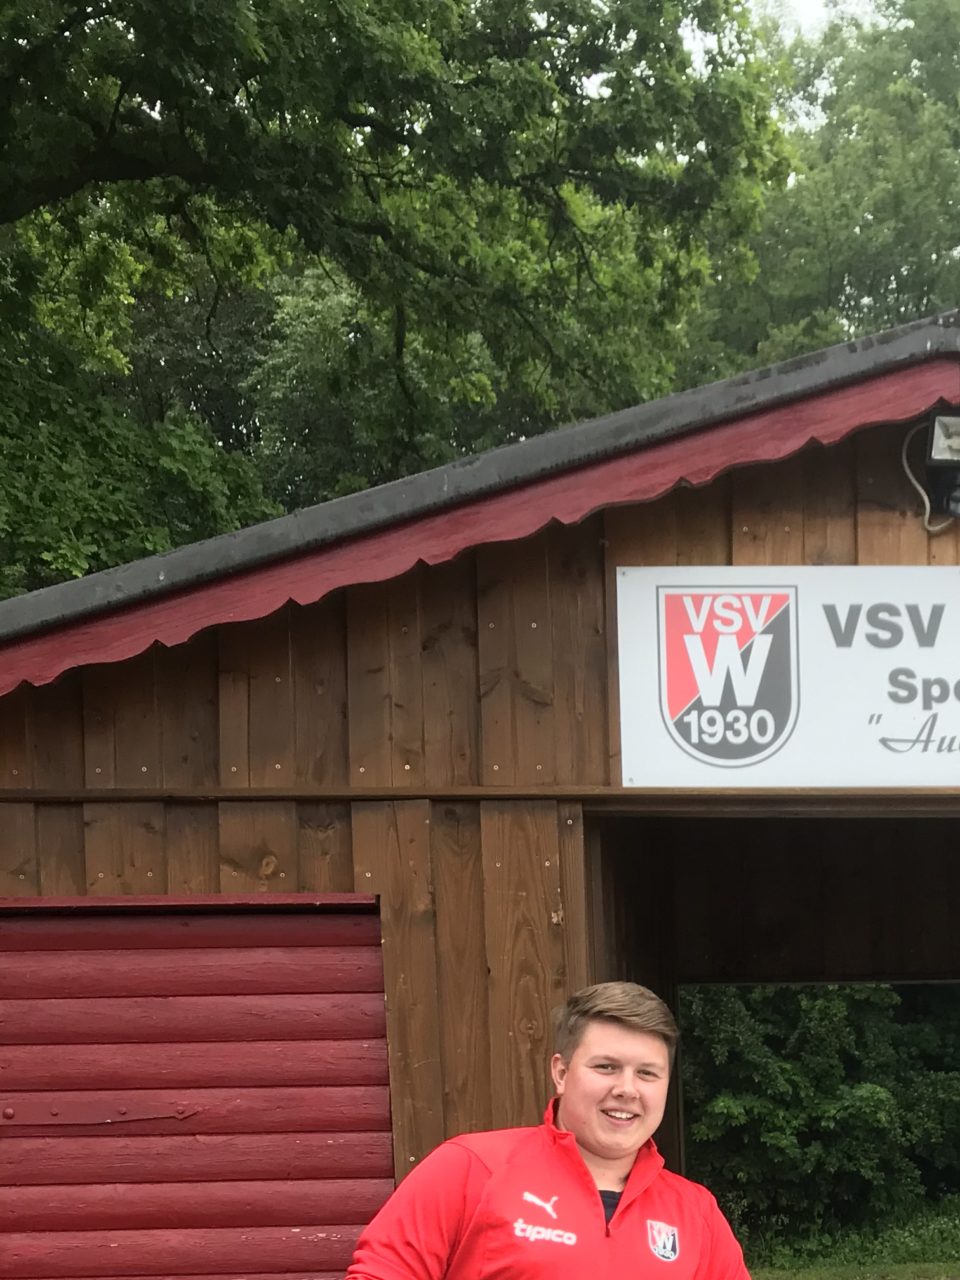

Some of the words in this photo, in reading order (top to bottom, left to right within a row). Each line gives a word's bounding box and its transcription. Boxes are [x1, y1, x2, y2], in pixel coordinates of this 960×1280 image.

[682, 594, 772, 634] VSV
[822, 603, 946, 648] VSV
[683, 633, 774, 707] W
[683, 709, 776, 745] 1930
[513, 1218, 577, 1246] tipico
